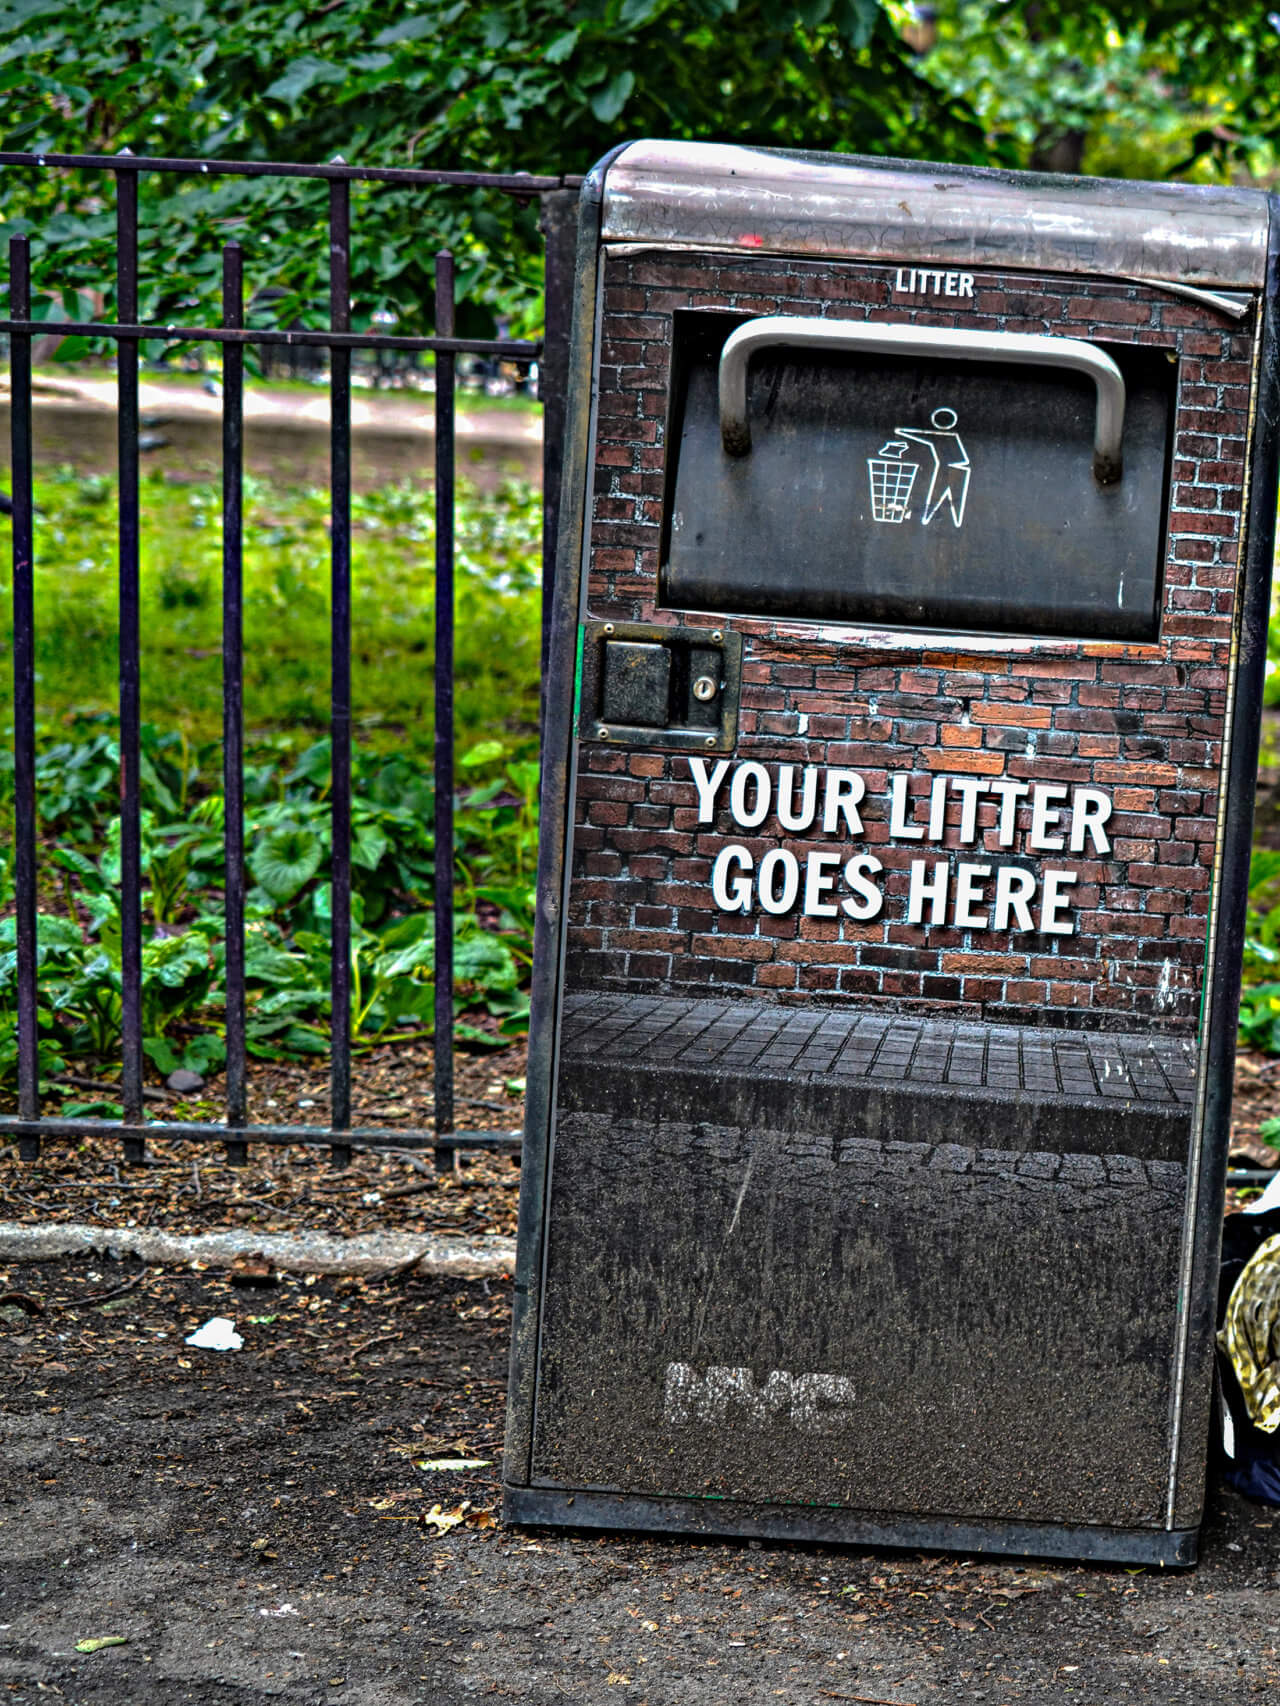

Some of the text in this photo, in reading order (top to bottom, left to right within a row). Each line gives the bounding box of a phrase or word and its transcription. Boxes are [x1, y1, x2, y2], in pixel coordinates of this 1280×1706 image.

[895, 268, 975, 298] LITTER
[688, 757, 1113, 854] YOUR LITTER
[712, 844, 1078, 935] GOES HERE
